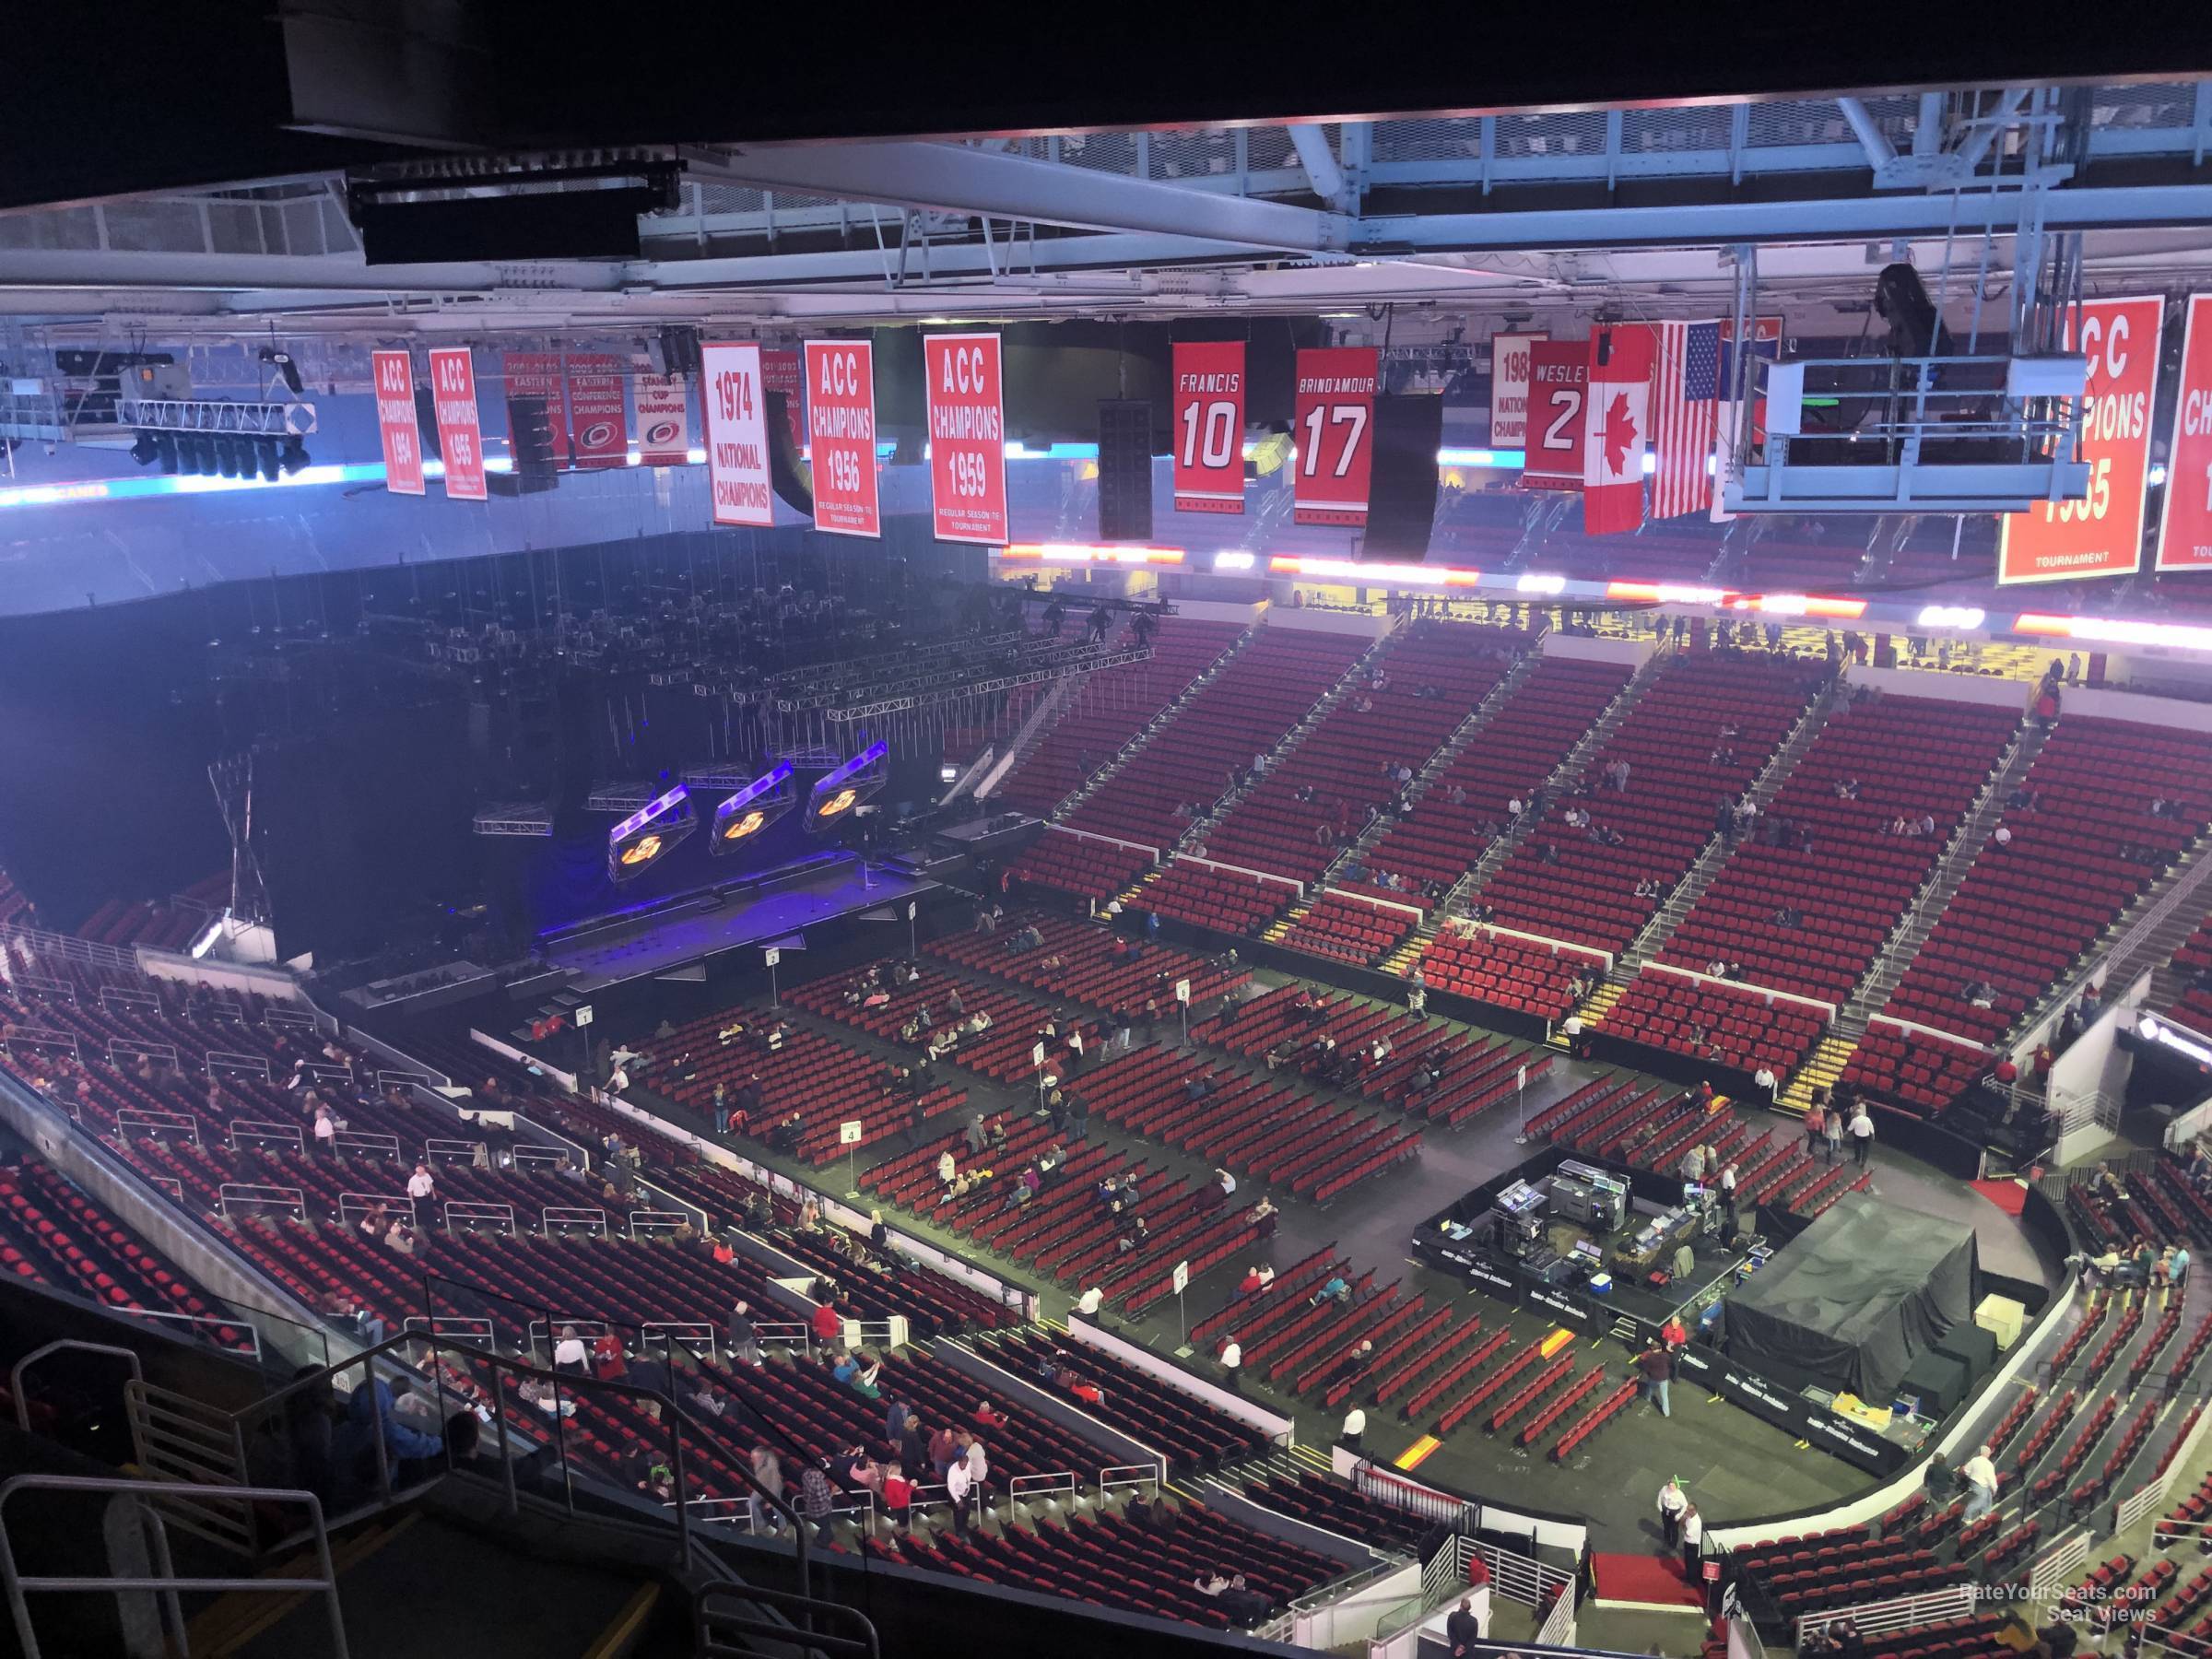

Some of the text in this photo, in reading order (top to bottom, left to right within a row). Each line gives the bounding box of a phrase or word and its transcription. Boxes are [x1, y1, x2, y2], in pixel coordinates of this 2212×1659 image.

[382, 359, 405, 393] ACC
[441, 358, 465, 393] ACC
[821, 352, 857, 396] ACC
[943, 347, 984, 394] ACC
[1503, 351, 1530, 382] 198
[572, 391, 620, 401] CONFERENCE
[653, 390, 669, 400] CUP
[715, 371, 753, 420] 1974
[1180, 373, 1240, 393] FRANCIS
[1299, 377, 1374, 394] BRIND'AMOUR
[380, 399, 414, 424] CHAMPIONS
[438, 399, 477, 425] CHAMPIONS
[574, 405, 622, 415] CHAMPIONS
[638, 404, 685, 414] CHAMPIONS
[1499, 396, 1528, 414] NATION
[813, 406, 871, 441] CHAMPIONS
[934, 405, 999, 441] CHAMPIONS
[1182, 400, 1237, 468] 10
[1494, 420, 1526, 438] CHAMPI
[1543, 390, 1583, 450] 2
[449, 433, 472, 465] 1955
[716, 442, 761, 470] NATIONAL
[1304, 406, 1368, 477] 17
[828, 449, 860, 493] 1956
[948, 451, 986, 498] 1959
[716, 481, 768, 510] CHAMPIONS
[938, 508, 965, 517] REGULAR
[967, 510, 990, 520] SEASON
[951, 522, 991, 532] TOURNAMENT
[2035, 551, 2110, 568] TOURNAMENT
